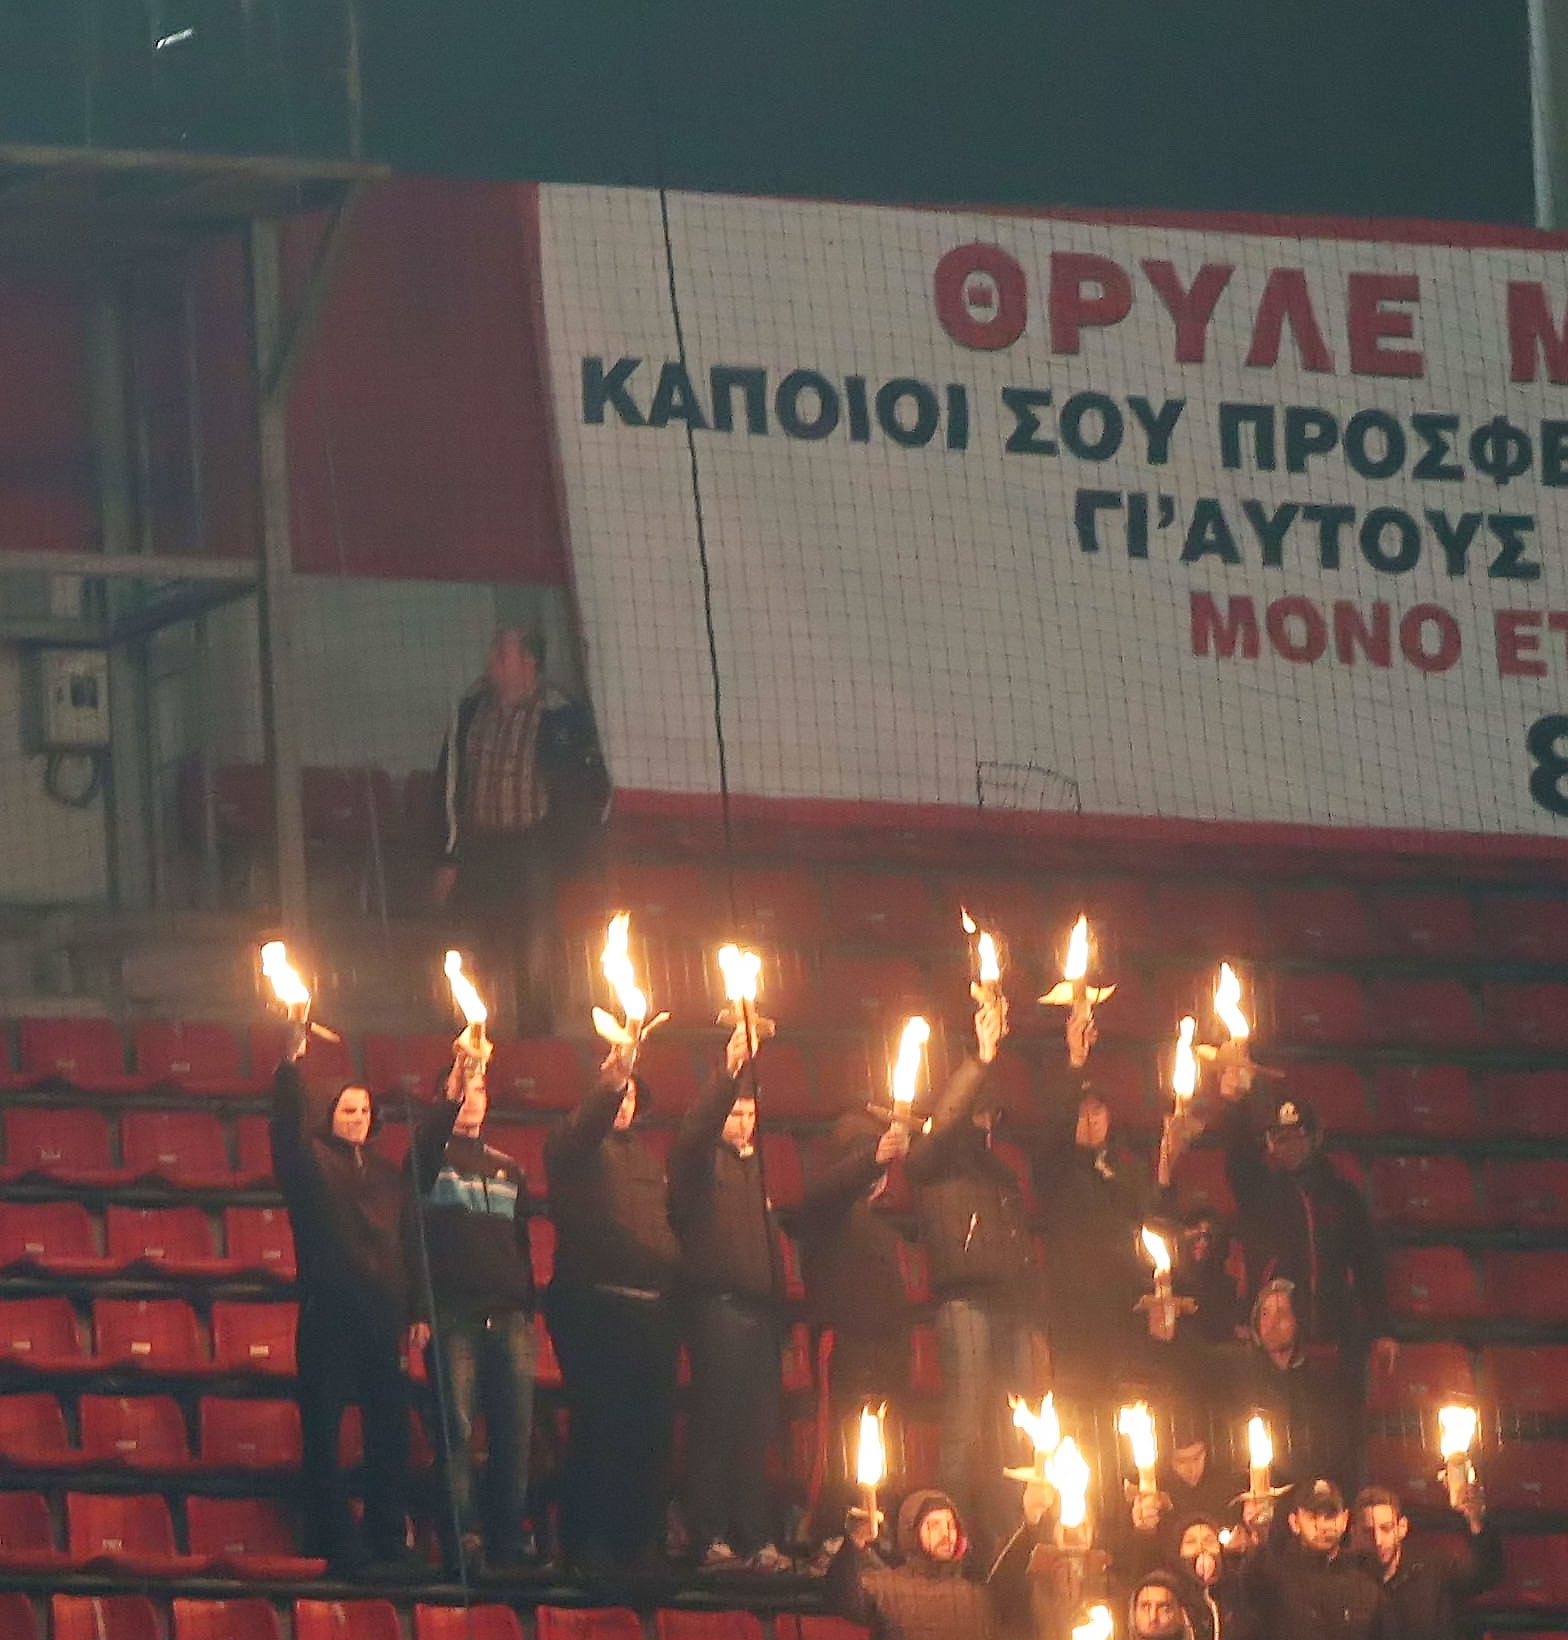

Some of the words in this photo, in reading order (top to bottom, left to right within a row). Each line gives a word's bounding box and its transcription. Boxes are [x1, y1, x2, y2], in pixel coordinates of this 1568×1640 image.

[933, 242, 1426, 378] ΘΡΥΛΕ
[582, 357, 969, 450] ΚΑΠΟΙΟΙ
[1002, 388, 1186, 464] ΣΟΥ
[1189, 591, 1462, 672] ΜΟΝΟ
